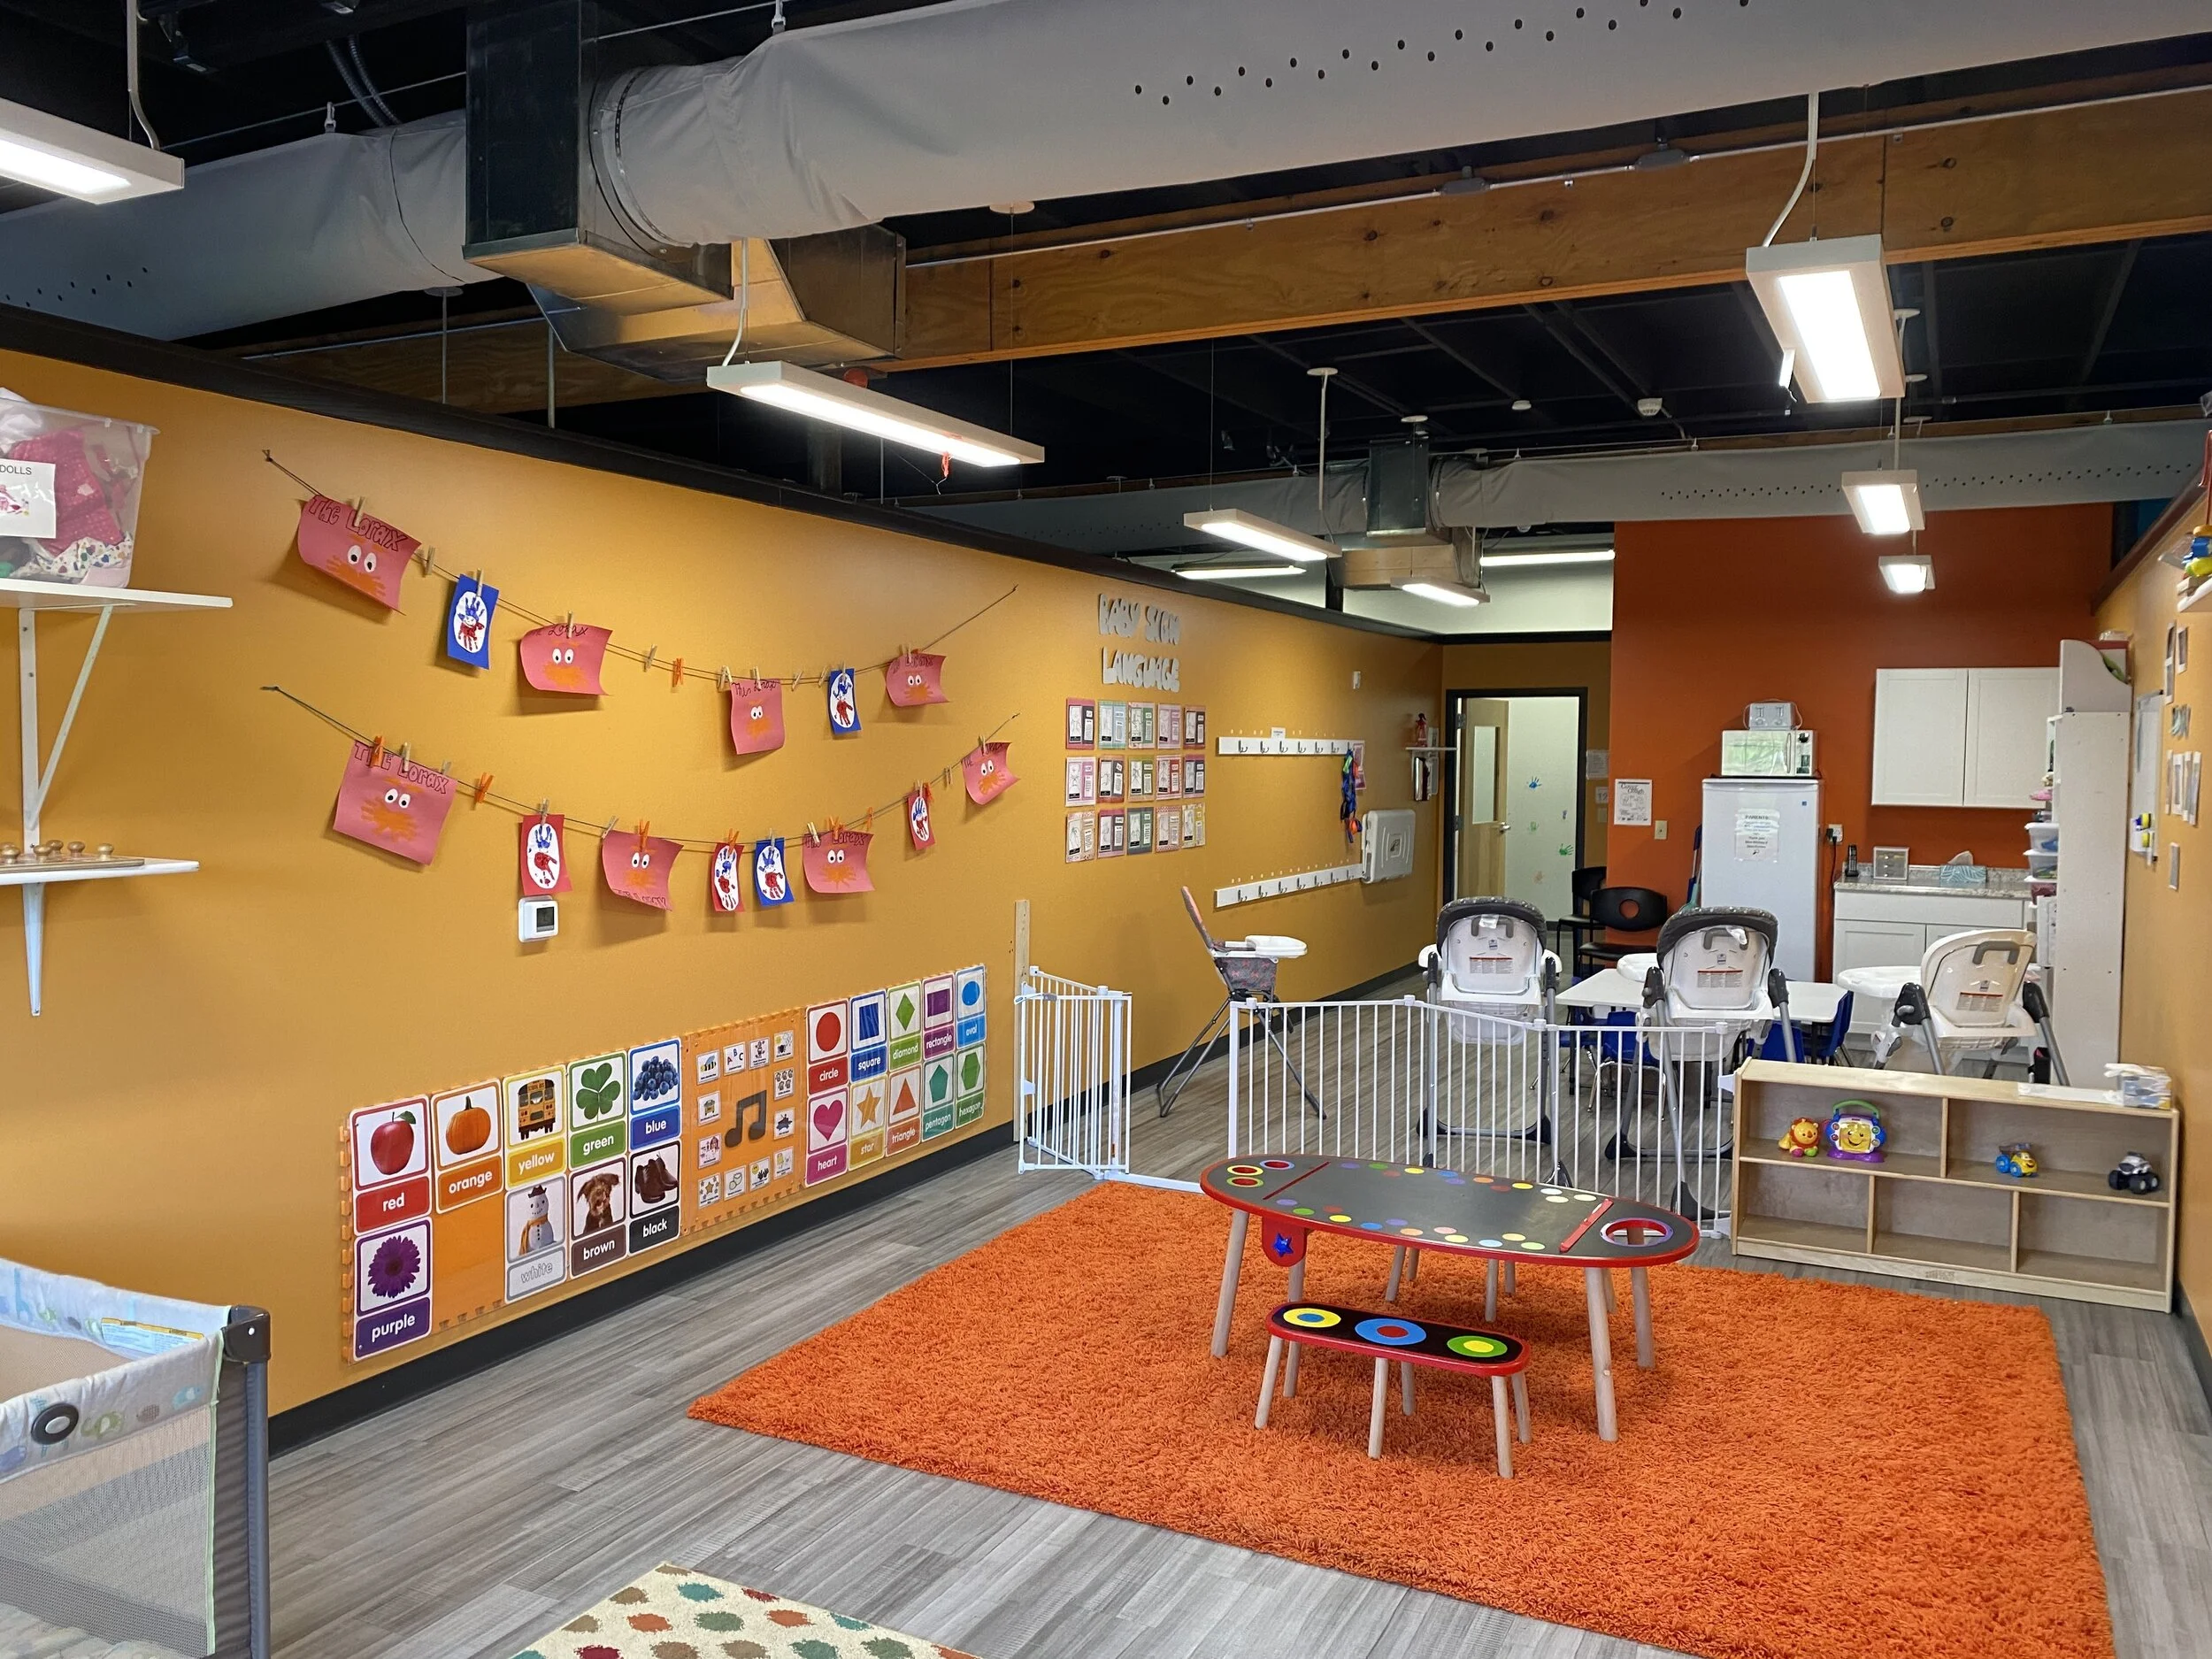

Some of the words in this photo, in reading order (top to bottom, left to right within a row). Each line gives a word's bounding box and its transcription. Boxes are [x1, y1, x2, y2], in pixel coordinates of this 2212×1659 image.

[0, 465, 32, 475] DOLLS
[308, 495, 341, 525] The
[345, 509, 408, 551] Lorax
[1099, 593, 1141, 638] BABY
[1145, 604, 1181, 645] SIGN
[1102, 646, 1180, 693] LANGUAGE
[397, 759, 449, 795] Lorax
[965, 1025, 978, 1037] oval
[926, 1033, 953, 1050] rectangle
[893, 1044, 918, 1060] diamond
[857, 1056, 881, 1071] square
[818, 1067, 839, 1081] circle
[958, 1102, 981, 1118] hexagon
[645, 1118, 667, 1133] blue
[925, 1113, 952, 1133] pentagon
[583, 1134, 614, 1154] green
[892, 1127, 916, 1144] triangle
[860, 1141, 875, 1156] star
[518, 1152, 555, 1173] yellow
[817, 1155, 838, 1171] heart
[449, 1171, 493, 1193] orange
[382, 1194, 405, 1212] red
[642, 1218, 668, 1239] black
[583, 1239, 616, 1261] brown
[520, 1261, 553, 1284] white
[371, 1313, 416, 1343] purple
